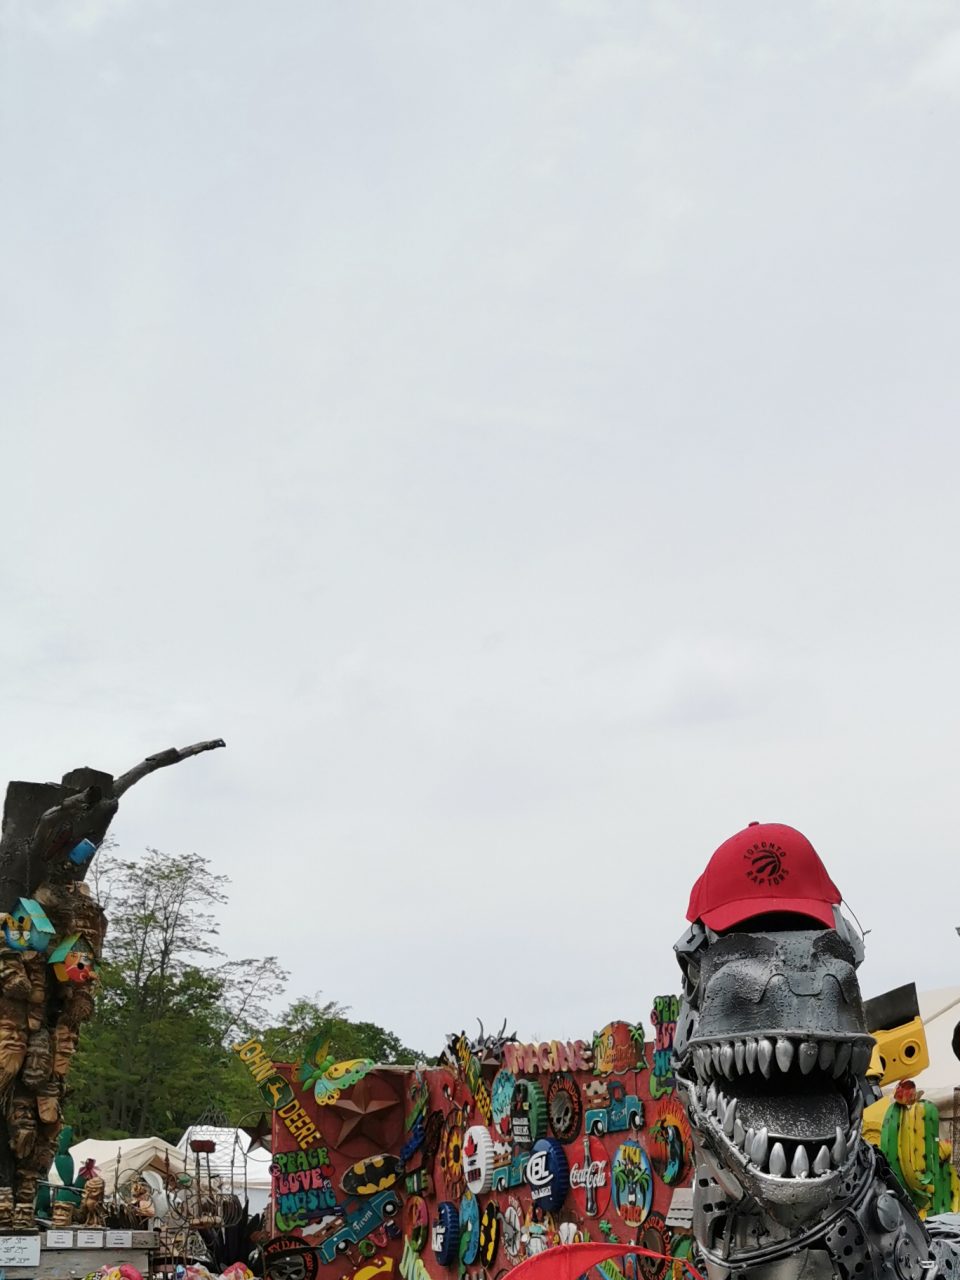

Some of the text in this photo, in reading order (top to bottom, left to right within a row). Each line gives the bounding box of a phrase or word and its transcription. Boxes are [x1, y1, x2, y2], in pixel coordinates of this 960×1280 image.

[744, 842, 786, 860] TORONTO
[746, 869, 789, 886] RAPTORS
[233, 1036, 321, 1149] JOHN DEERE
[277, 1147, 329, 1173] PEACE
[279, 1167, 322, 1194] LOVE
